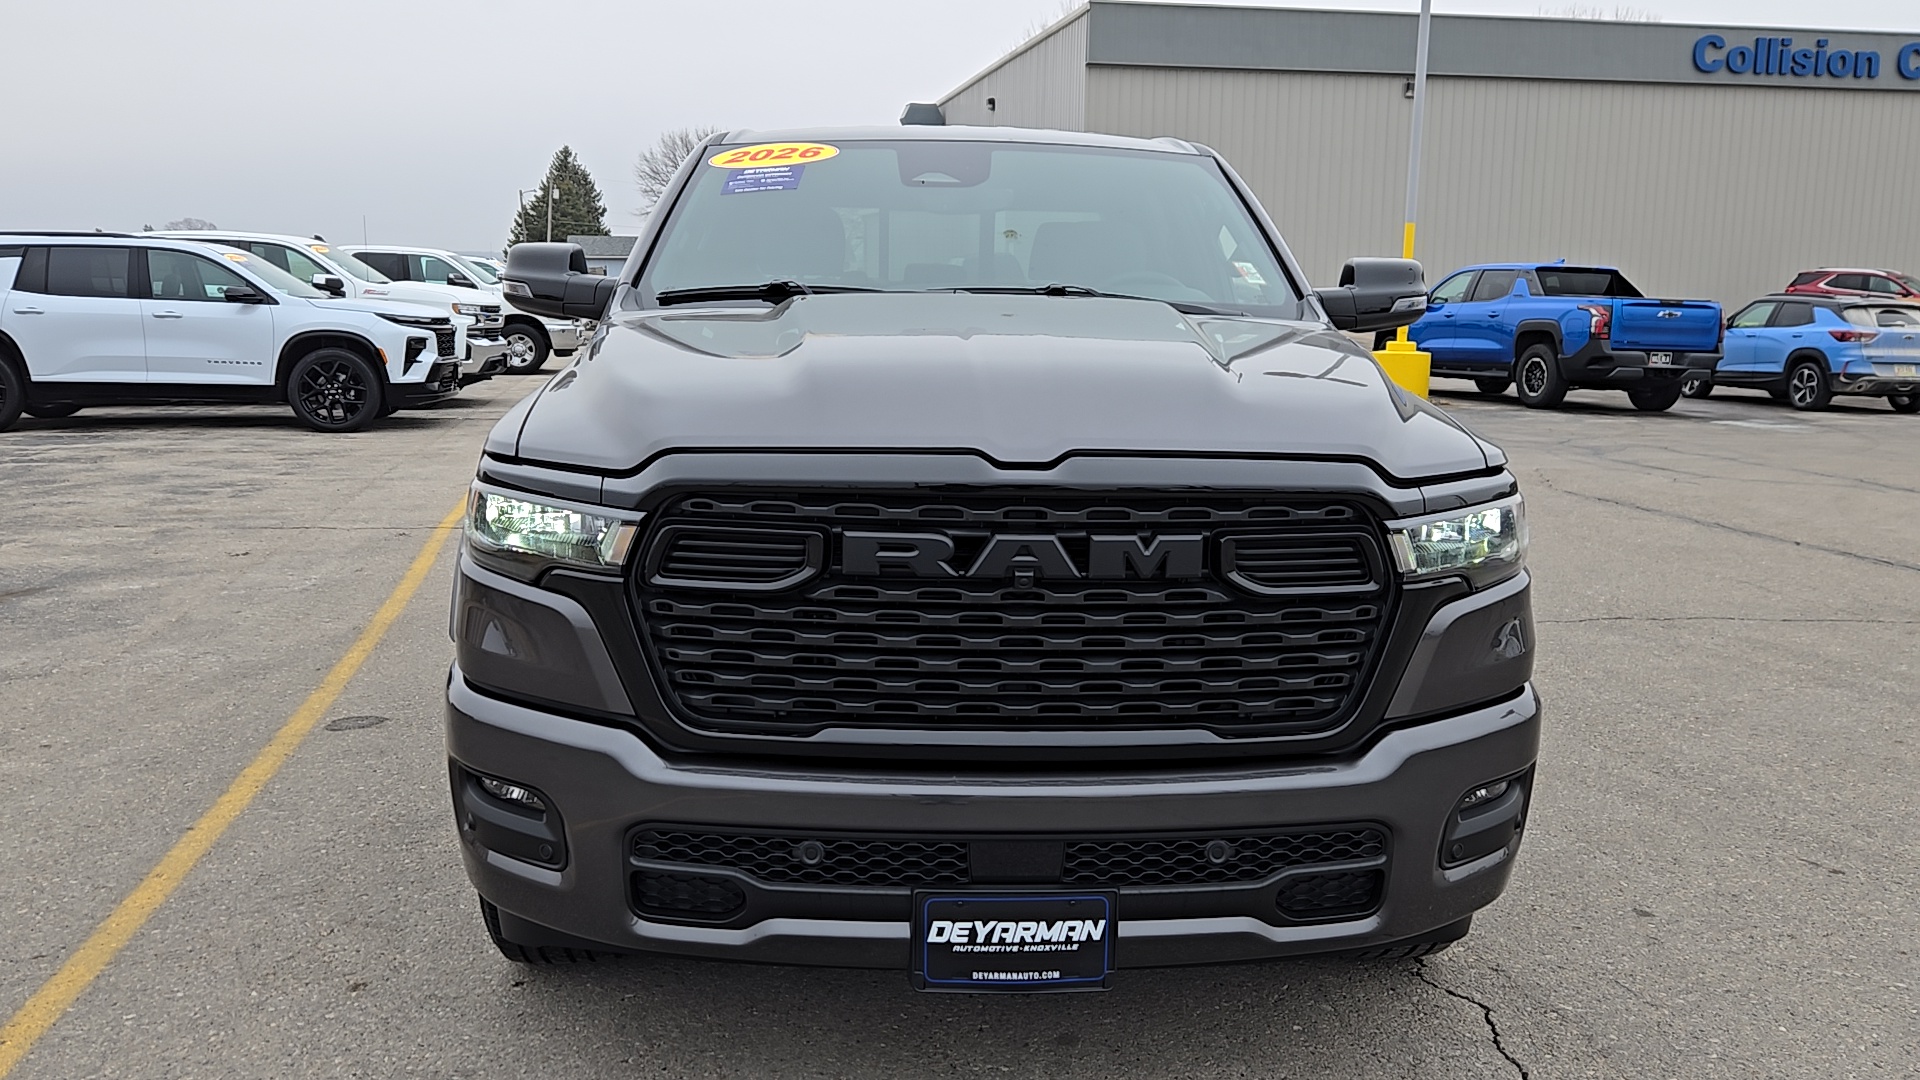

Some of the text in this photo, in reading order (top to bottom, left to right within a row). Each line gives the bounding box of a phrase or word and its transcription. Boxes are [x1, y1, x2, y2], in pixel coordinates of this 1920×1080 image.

[1693, 34, 1880, 79] Collision
[722, 147, 825, 164] 2026
[842, 530, 1204, 579] RAM
[926, 919, 1107, 943] DEYARMAN
[972, 971, 1061, 981] DEYARMANAUTO.COM
